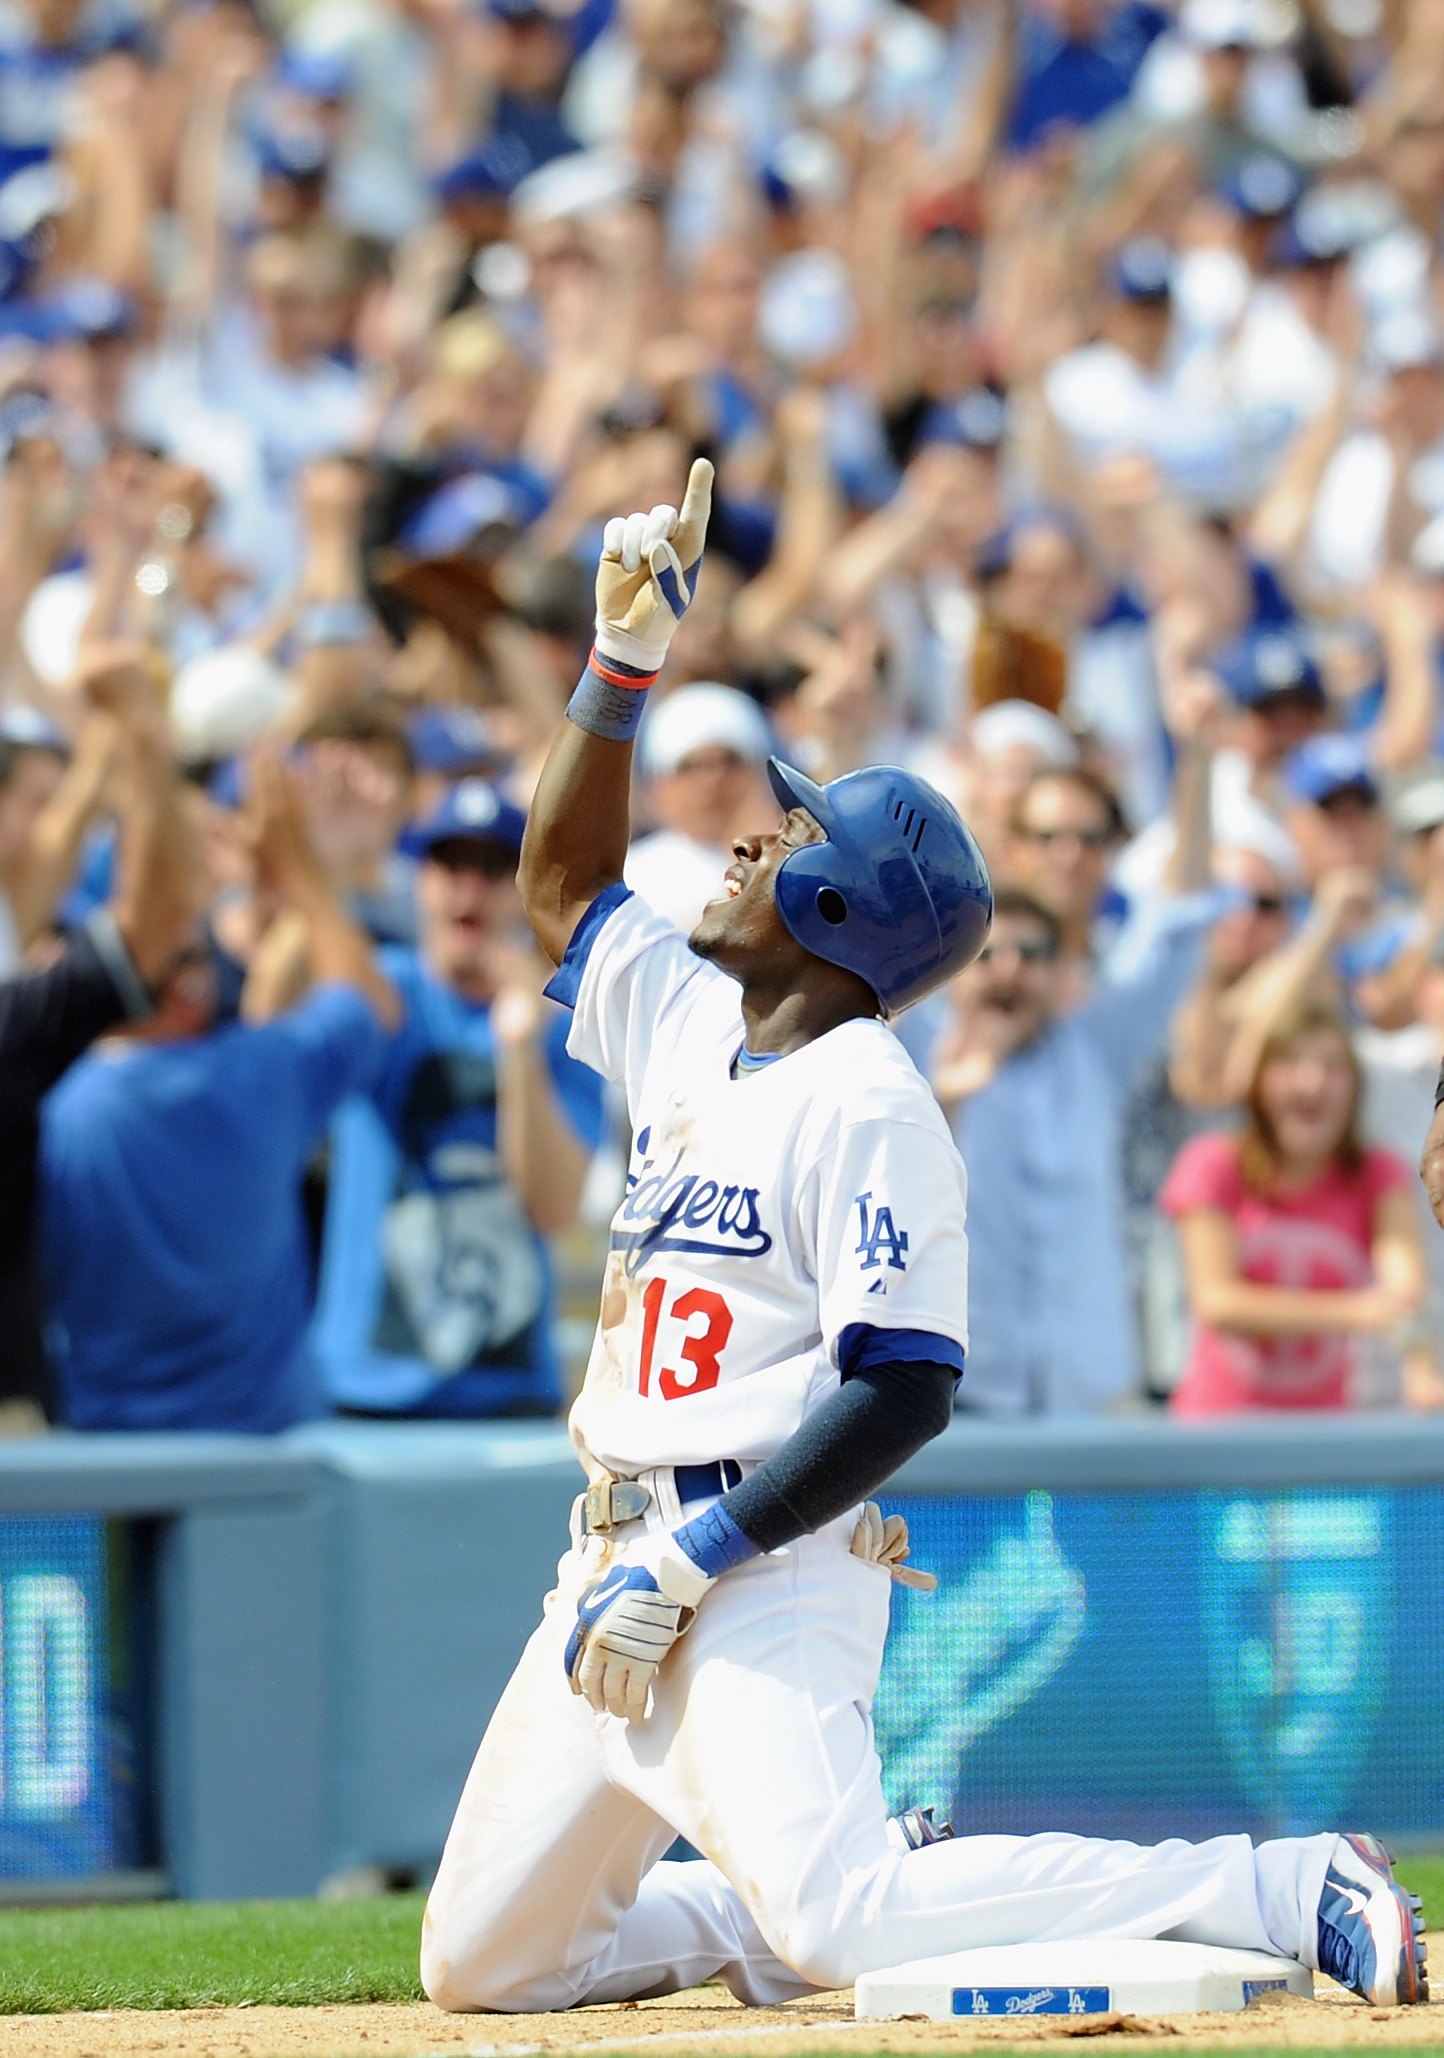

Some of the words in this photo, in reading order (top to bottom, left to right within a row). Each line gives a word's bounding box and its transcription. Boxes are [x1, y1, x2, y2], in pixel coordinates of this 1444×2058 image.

[611, 1125, 773, 1279] dgers
[855, 1191, 909, 1271] LA
[638, 1277, 734, 1401] 13
[970, 1989, 989, 2014] LA
[1005, 1988, 1057, 2014] Dodgers
[1067, 1988, 1086, 2014] LA
